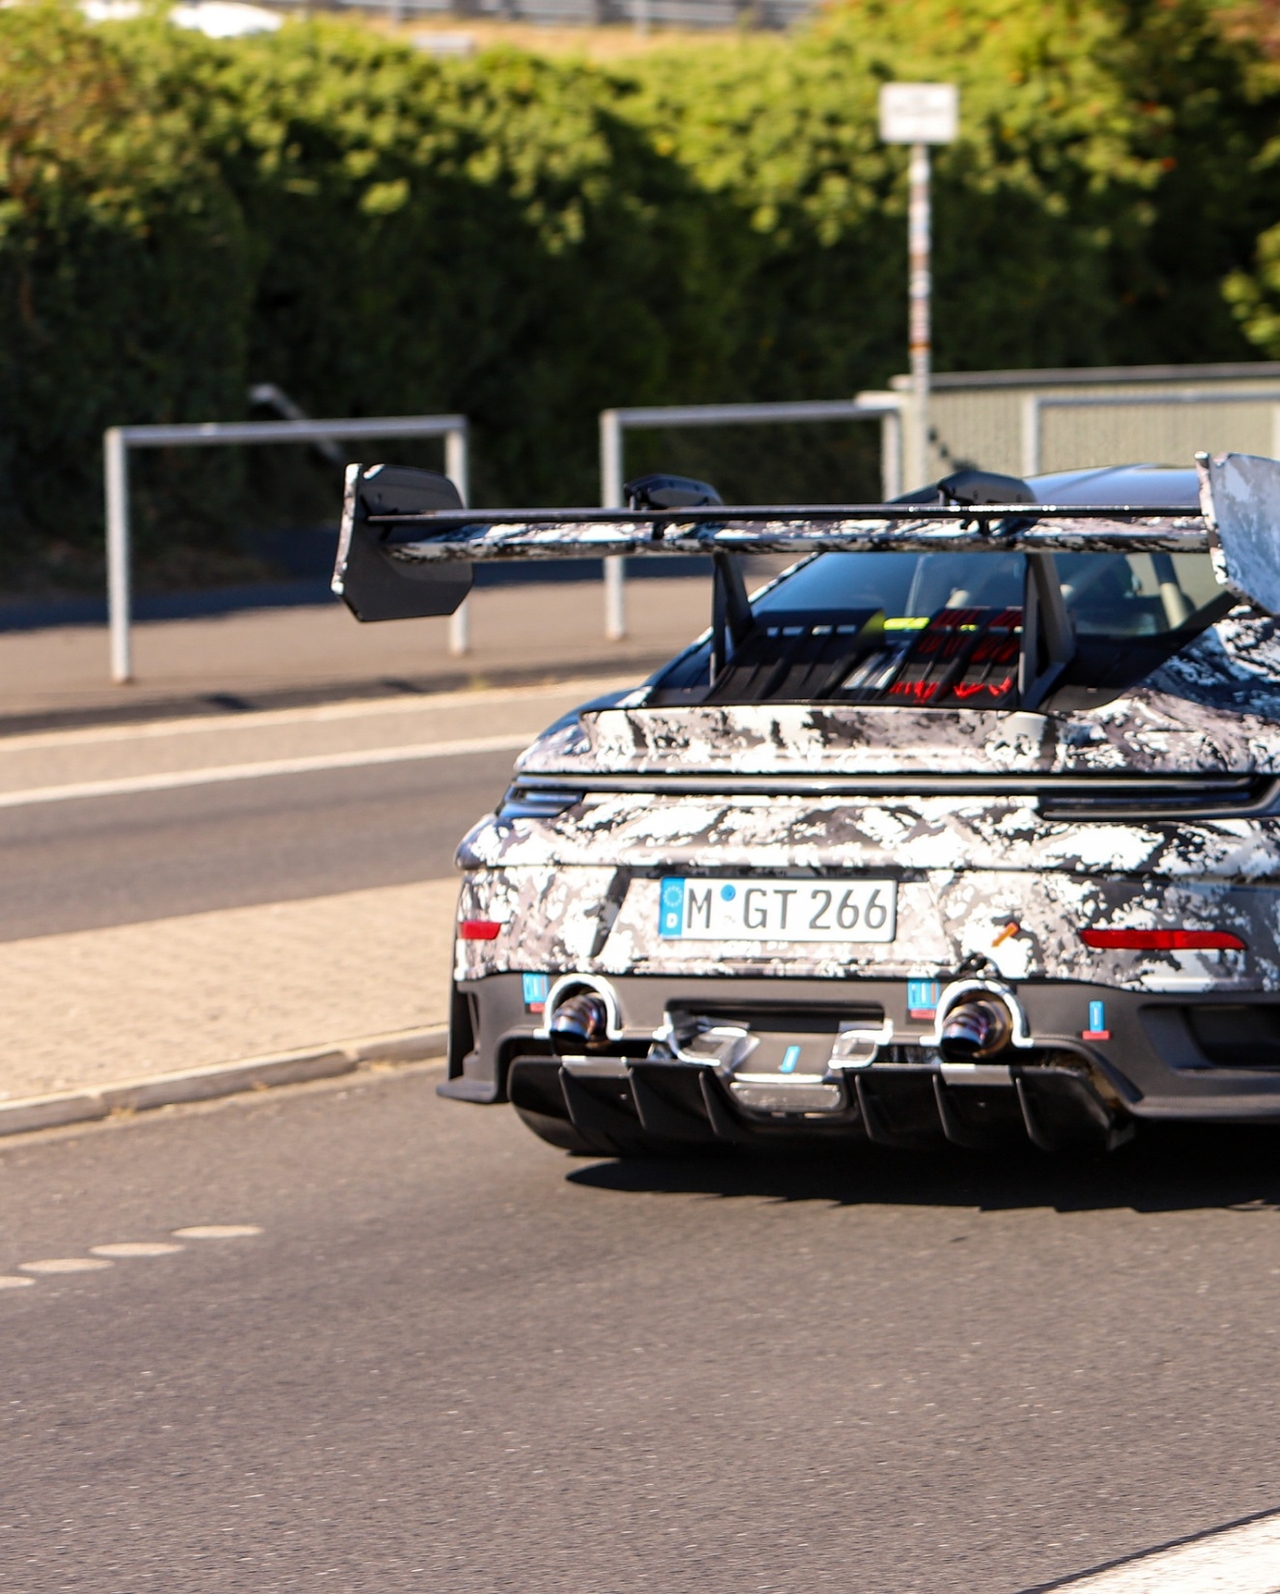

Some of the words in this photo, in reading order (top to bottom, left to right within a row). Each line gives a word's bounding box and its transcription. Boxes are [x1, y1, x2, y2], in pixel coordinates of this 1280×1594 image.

[665, 913, 679, 928] D
[686, 888, 712, 929] M
[743, 888, 797, 930] GT
[808, 888, 888, 930] 266
